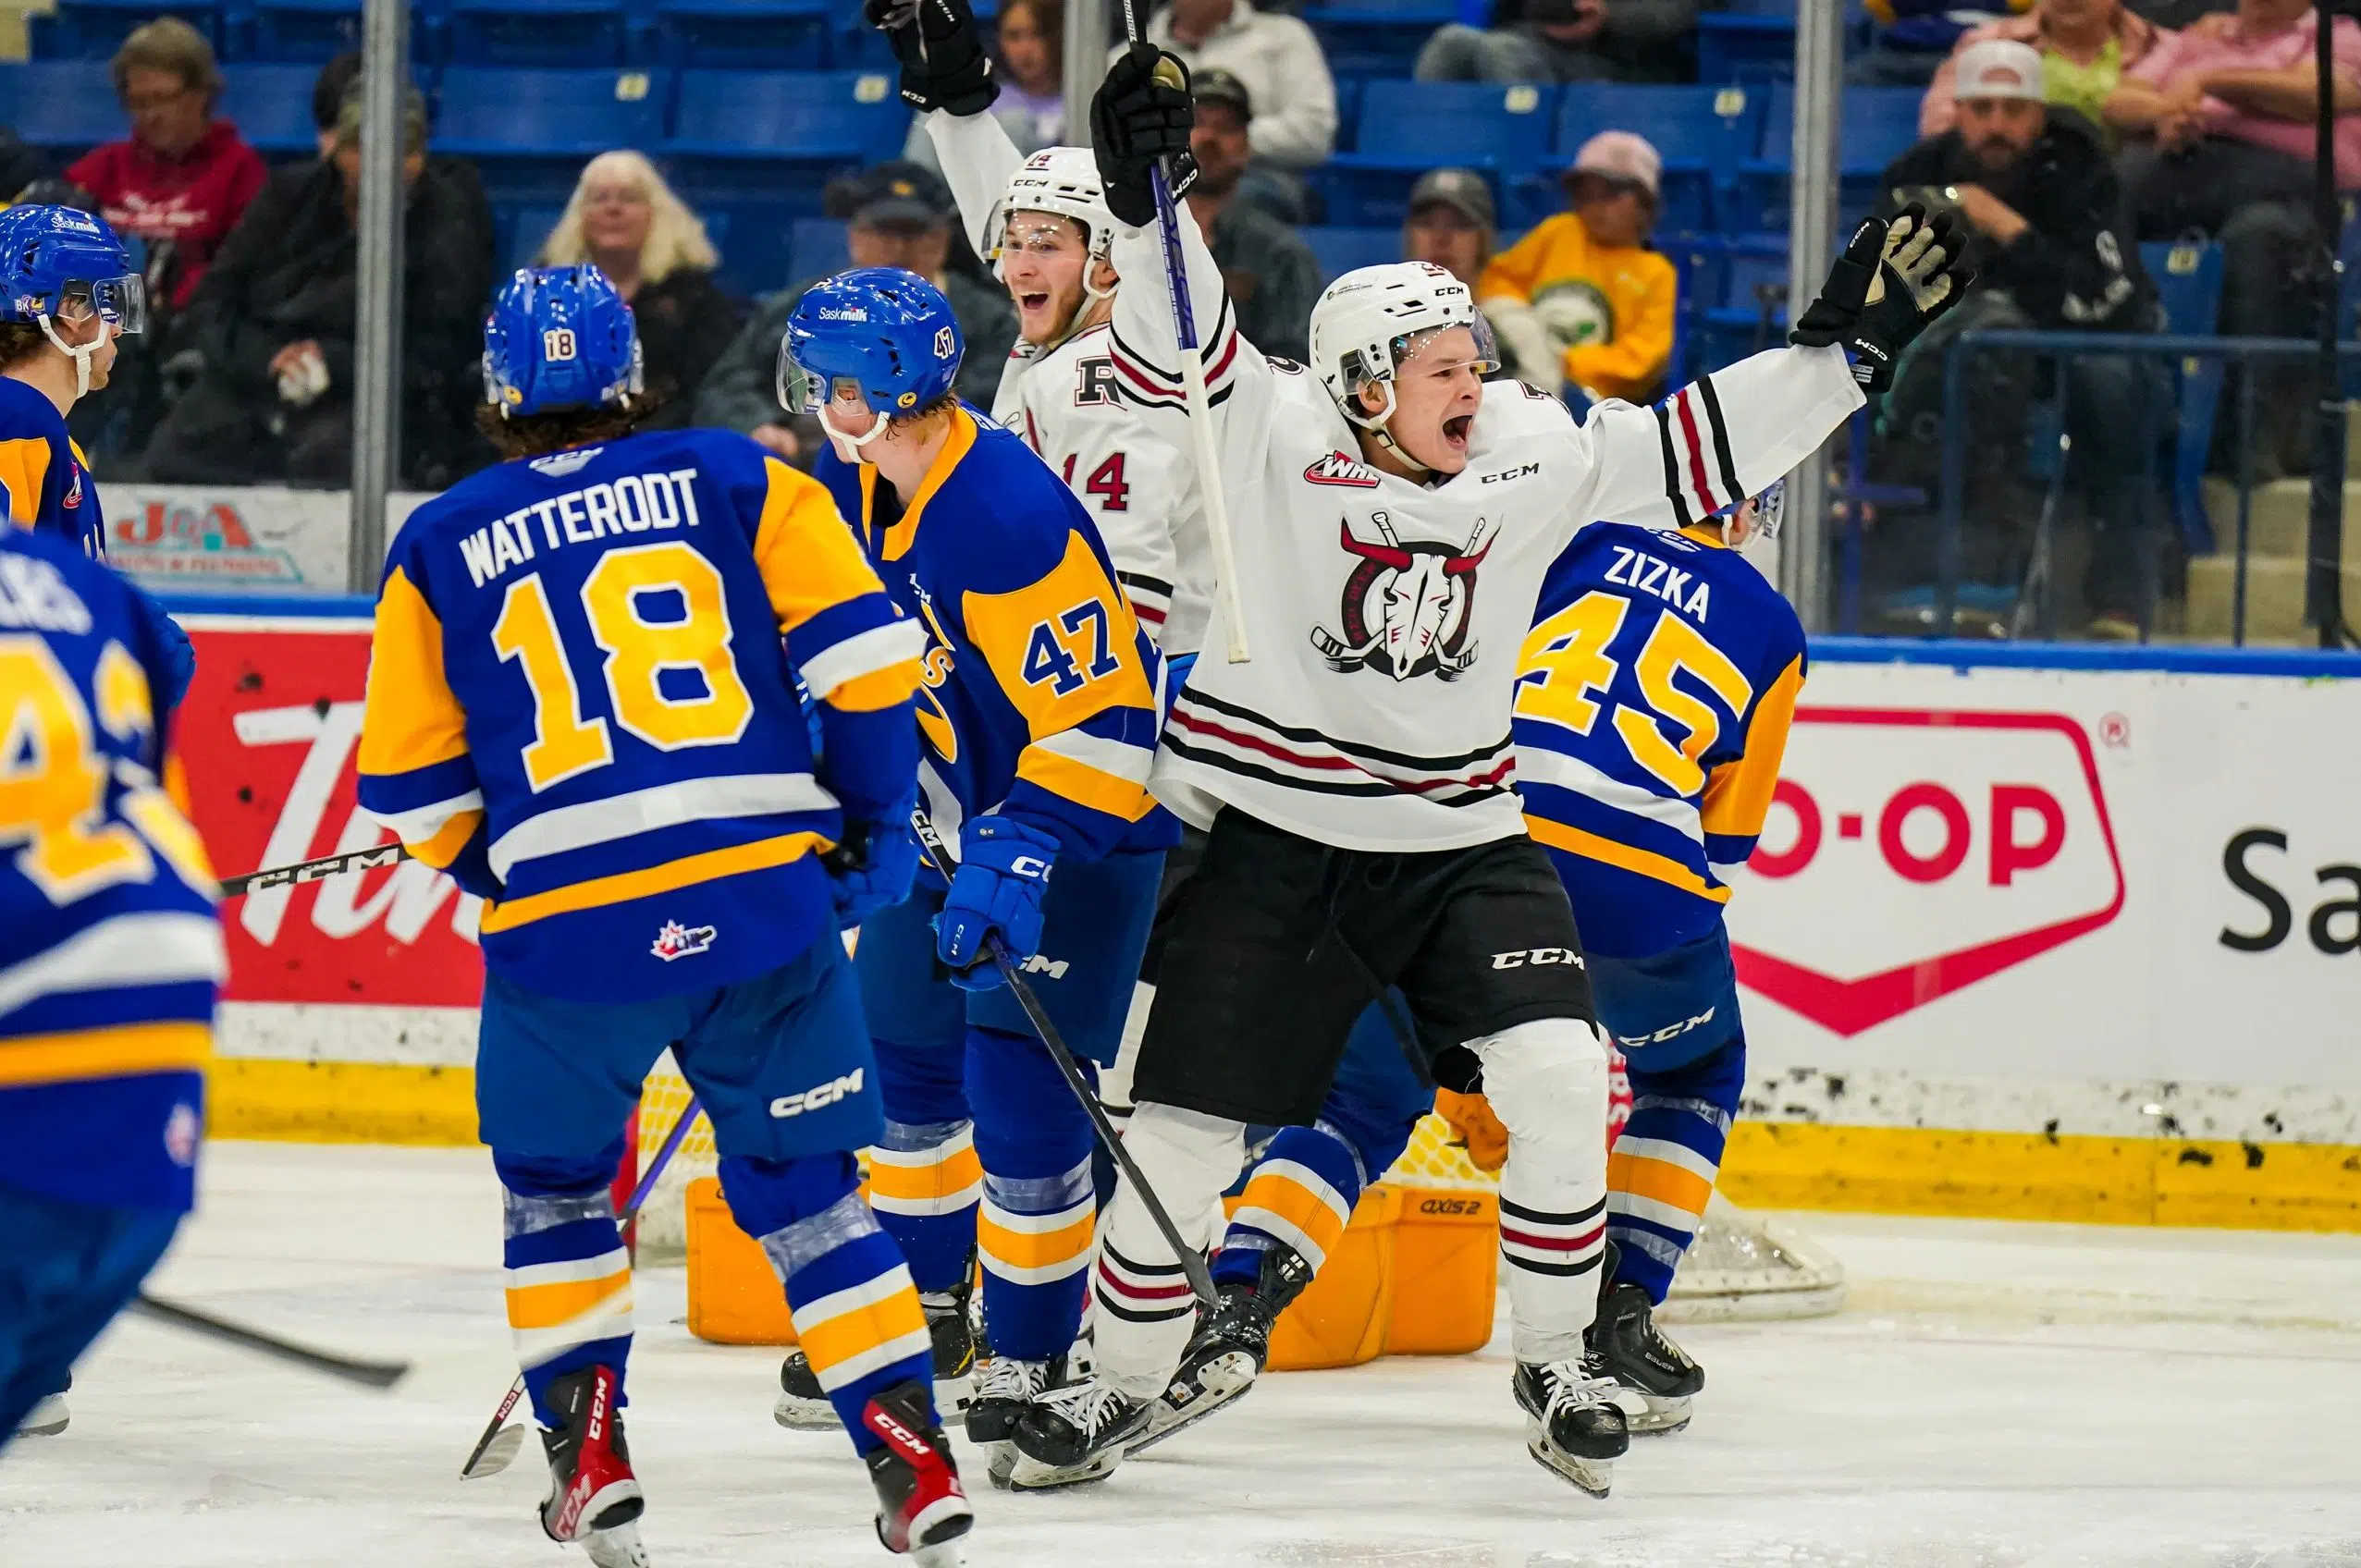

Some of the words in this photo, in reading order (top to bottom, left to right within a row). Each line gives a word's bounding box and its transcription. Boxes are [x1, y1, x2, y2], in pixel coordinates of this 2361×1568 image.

[1014, 179, 1049, 188] CCM
[1172, 167, 1199, 200] CCM
[1434, 287, 1464, 297] CCM
[818, 306, 867, 323] Saskmilk
[544, 328, 577, 361] 18
[933, 325, 955, 361] 47
[1855, 337, 1888, 362] CCM
[1482, 462, 1540, 485] CCM
[459, 468, 700, 589] WATTERODT
[1604, 545, 1710, 624] ZIZKA
[490, 540, 755, 795] 18
[1019, 596, 1123, 700] 47
[1512, 589, 1753, 799] 45
[910, 800, 943, 848] CM
[247, 847, 400, 895] CCM
[951, 925, 965, 956] CCM
[1491, 948, 1585, 971] CCM
[1618, 1006, 1715, 1047] CCM
[769, 1067, 864, 1119] CCM
[497, 1390, 520, 1421] CCM
[588, 1377, 608, 1441] CCM
[873, 1412, 931, 1456] CCM
[555, 1474, 593, 1540] CCM
